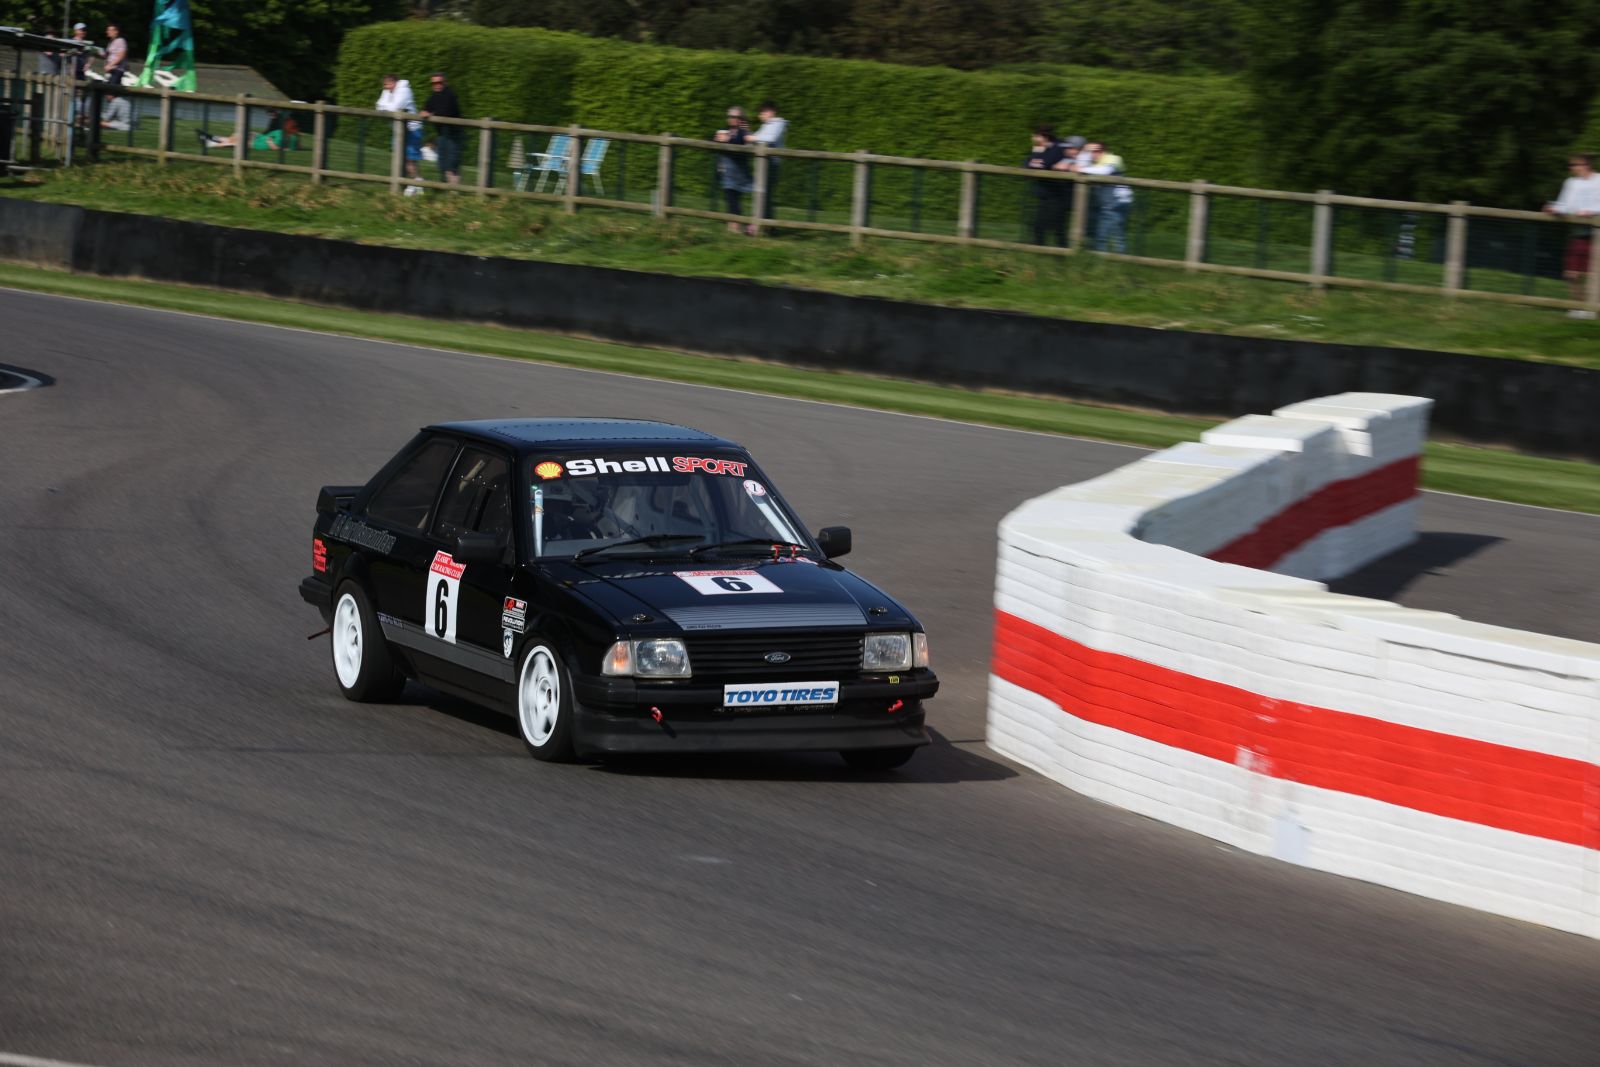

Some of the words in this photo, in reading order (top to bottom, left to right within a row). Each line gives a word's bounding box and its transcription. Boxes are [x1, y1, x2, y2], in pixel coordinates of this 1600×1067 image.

[565, 457, 670, 476] Shell
[672, 456, 747, 477] SPORT
[711, 576, 753, 592] 6
[435, 578, 449, 639] 6
[726, 690, 778, 704] TOYO
[780, 687, 836, 702] TIRES
